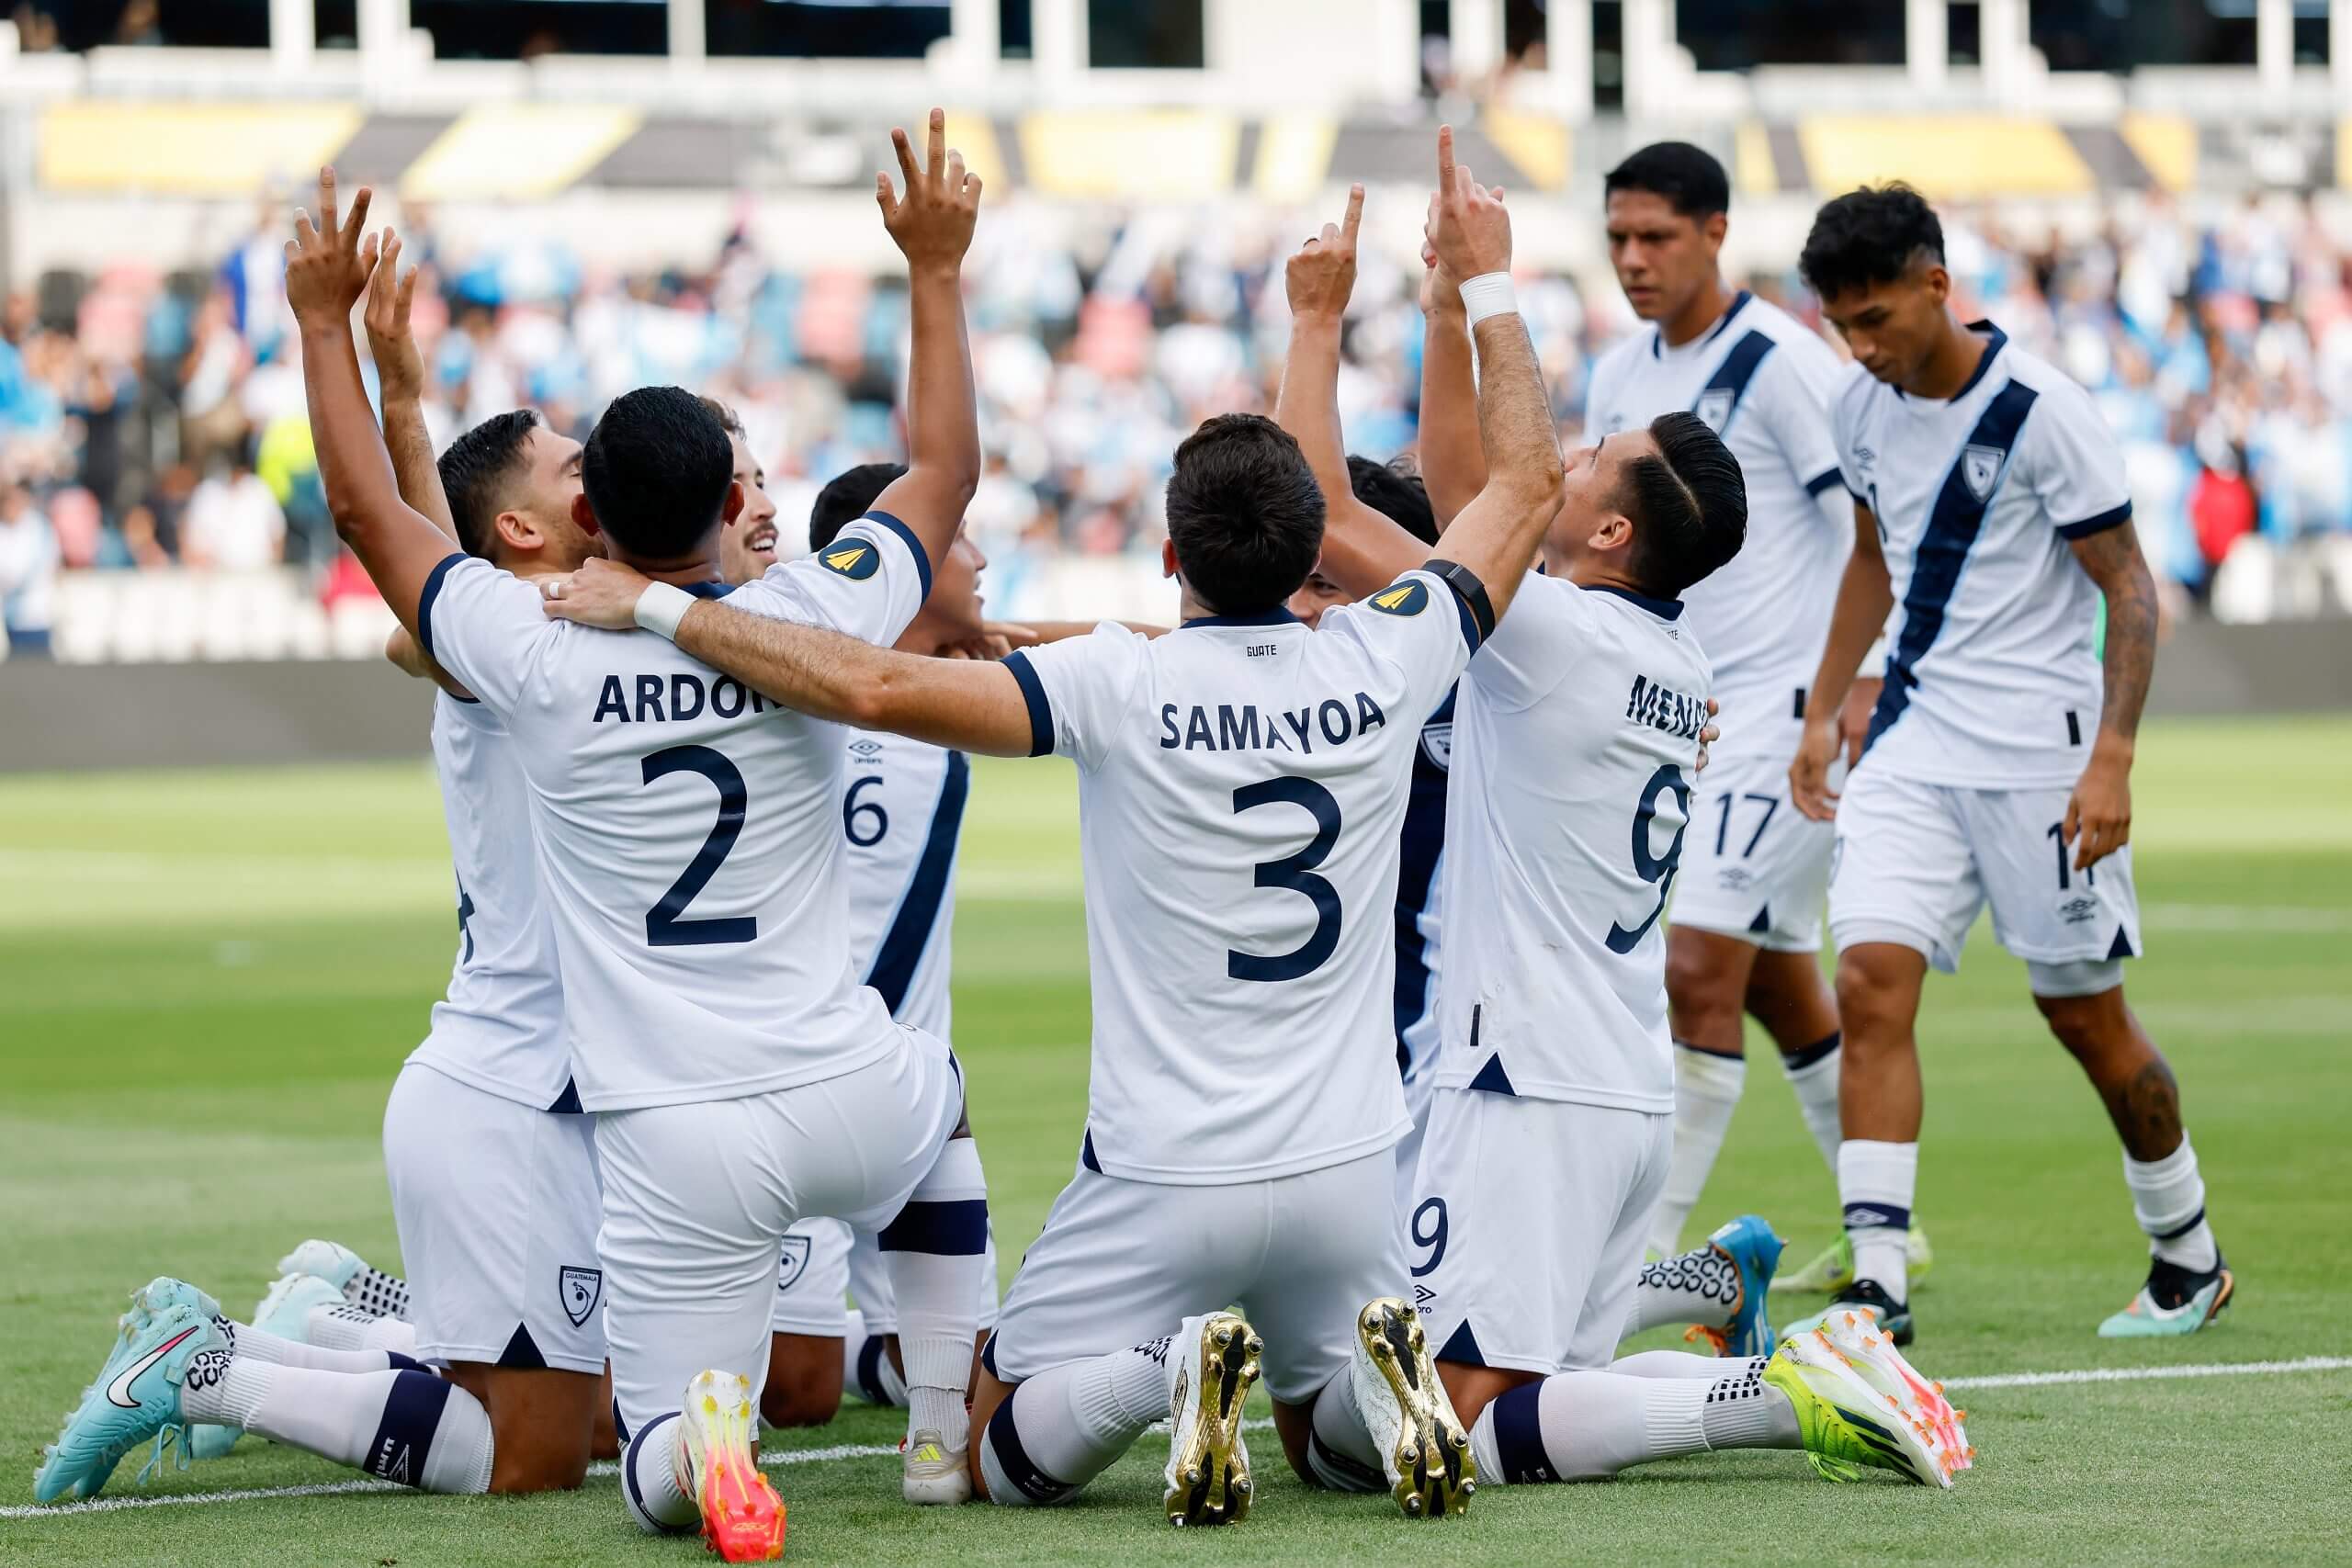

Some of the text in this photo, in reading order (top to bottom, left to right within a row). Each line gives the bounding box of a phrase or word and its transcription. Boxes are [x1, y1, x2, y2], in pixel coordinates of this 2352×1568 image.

[1247, 644, 1277, 658] GUATE
[1160, 691, 1386, 755] SAMAYOA
[641, 744, 758, 947] 2
[842, 775, 888, 847] 6
[1716, 793, 1780, 859] 17
[1227, 775, 1342, 982] 3
[1604, 763, 1690, 955] 9
[1409, 1197, 1449, 1278] 9
